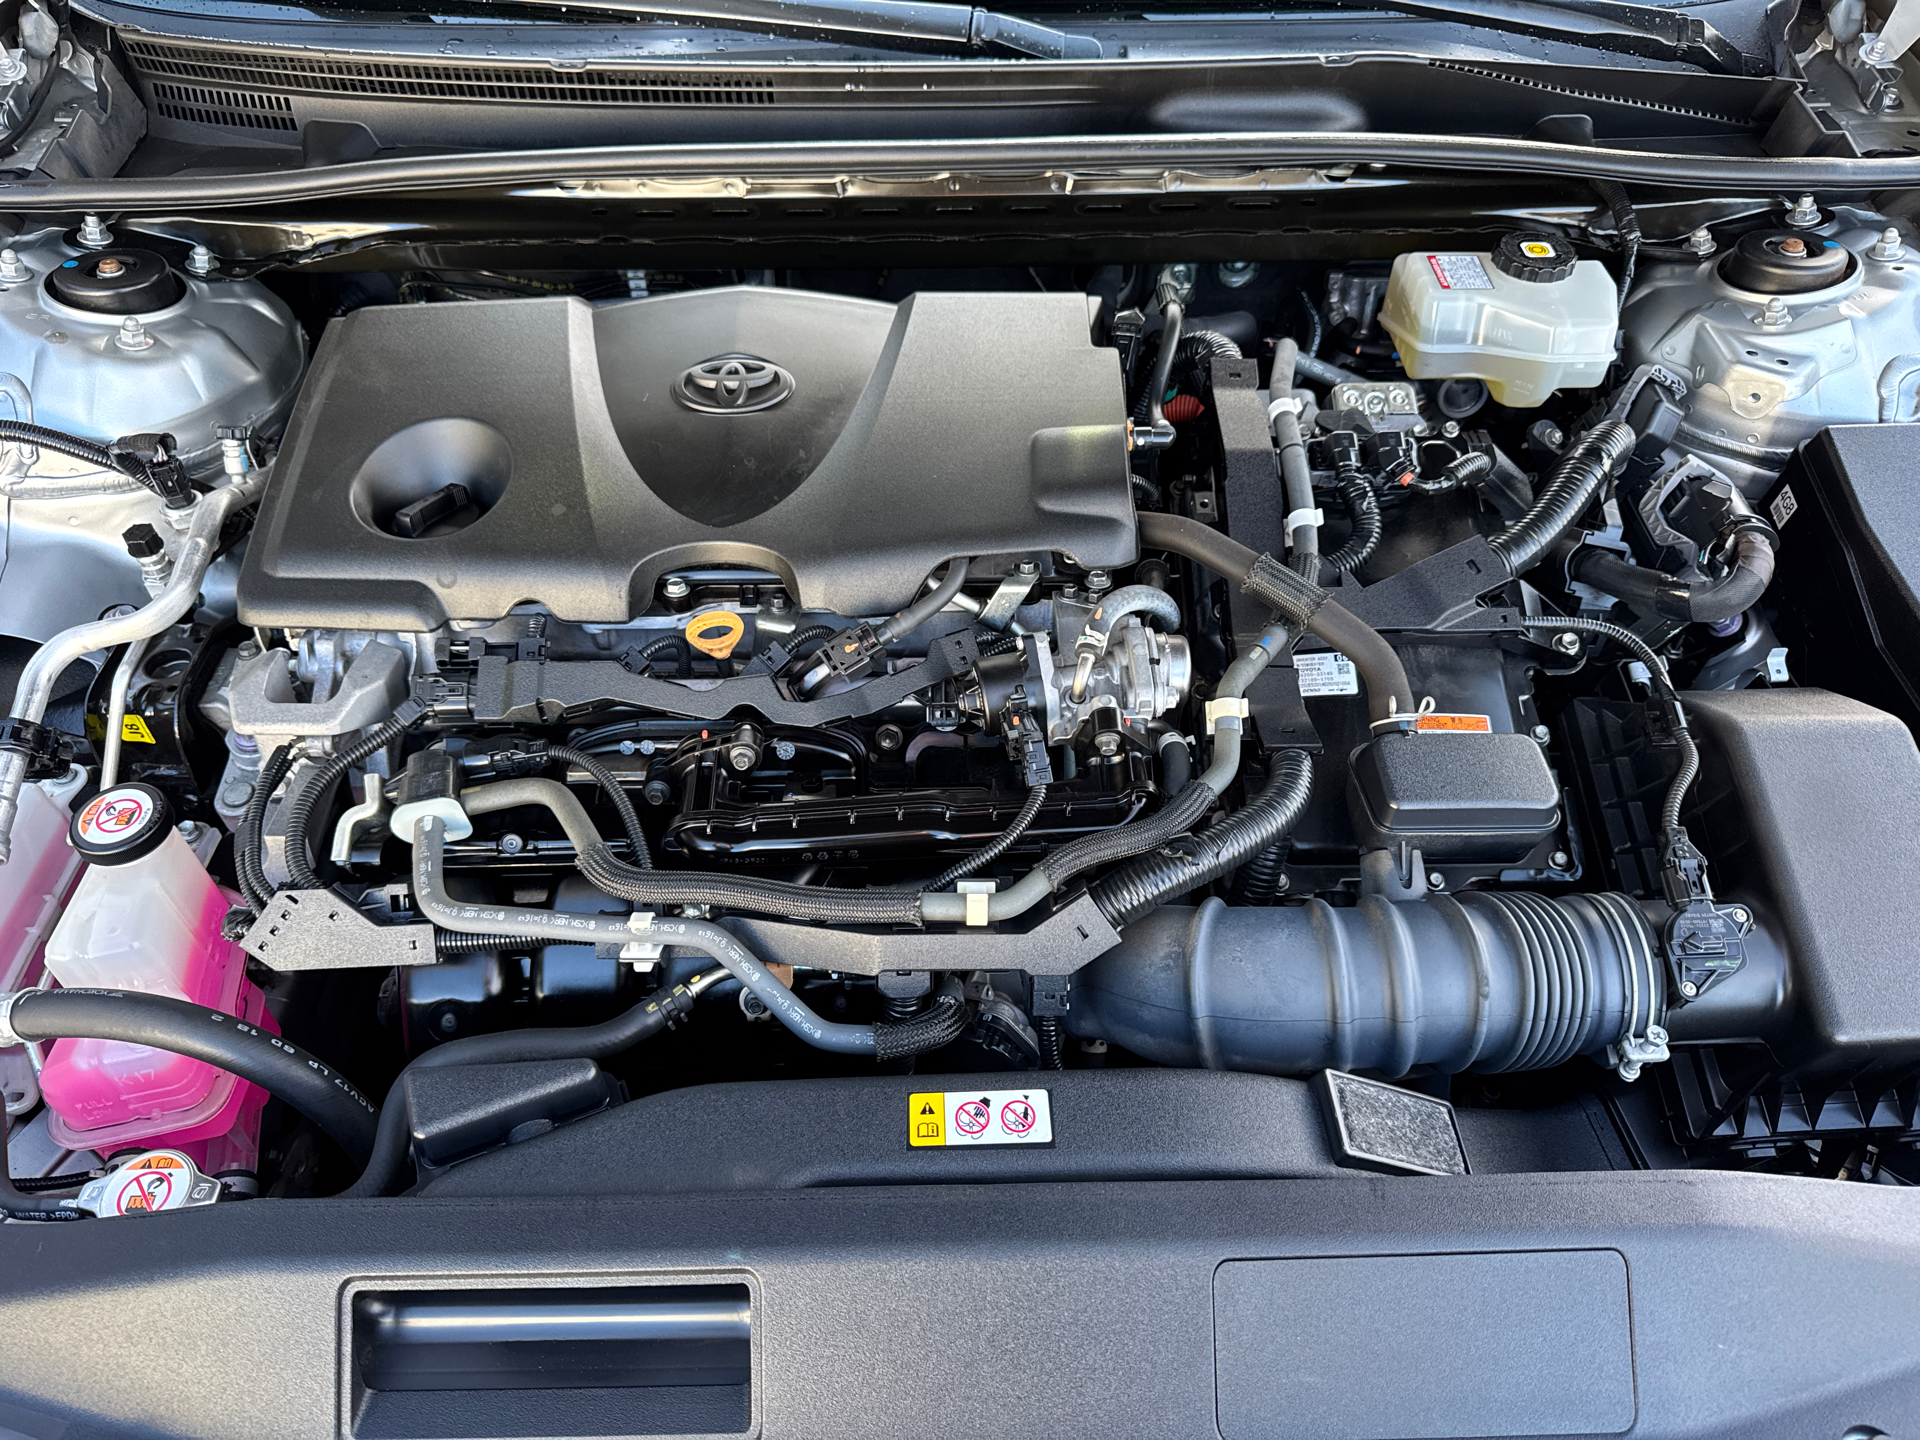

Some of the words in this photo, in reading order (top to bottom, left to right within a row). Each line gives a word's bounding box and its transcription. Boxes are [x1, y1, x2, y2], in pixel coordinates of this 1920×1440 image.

[1513, 379, 1534, 391] MIN
[1780, 491, 1795, 516] 4G8
[125, 723, 145, 738] J8
[308, 1060, 330, 1077] LP
[113, 1069, 155, 1087] K17
[334, 1078, 376, 1113] ACV17
[15, 1211, 47, 1220] WATER
